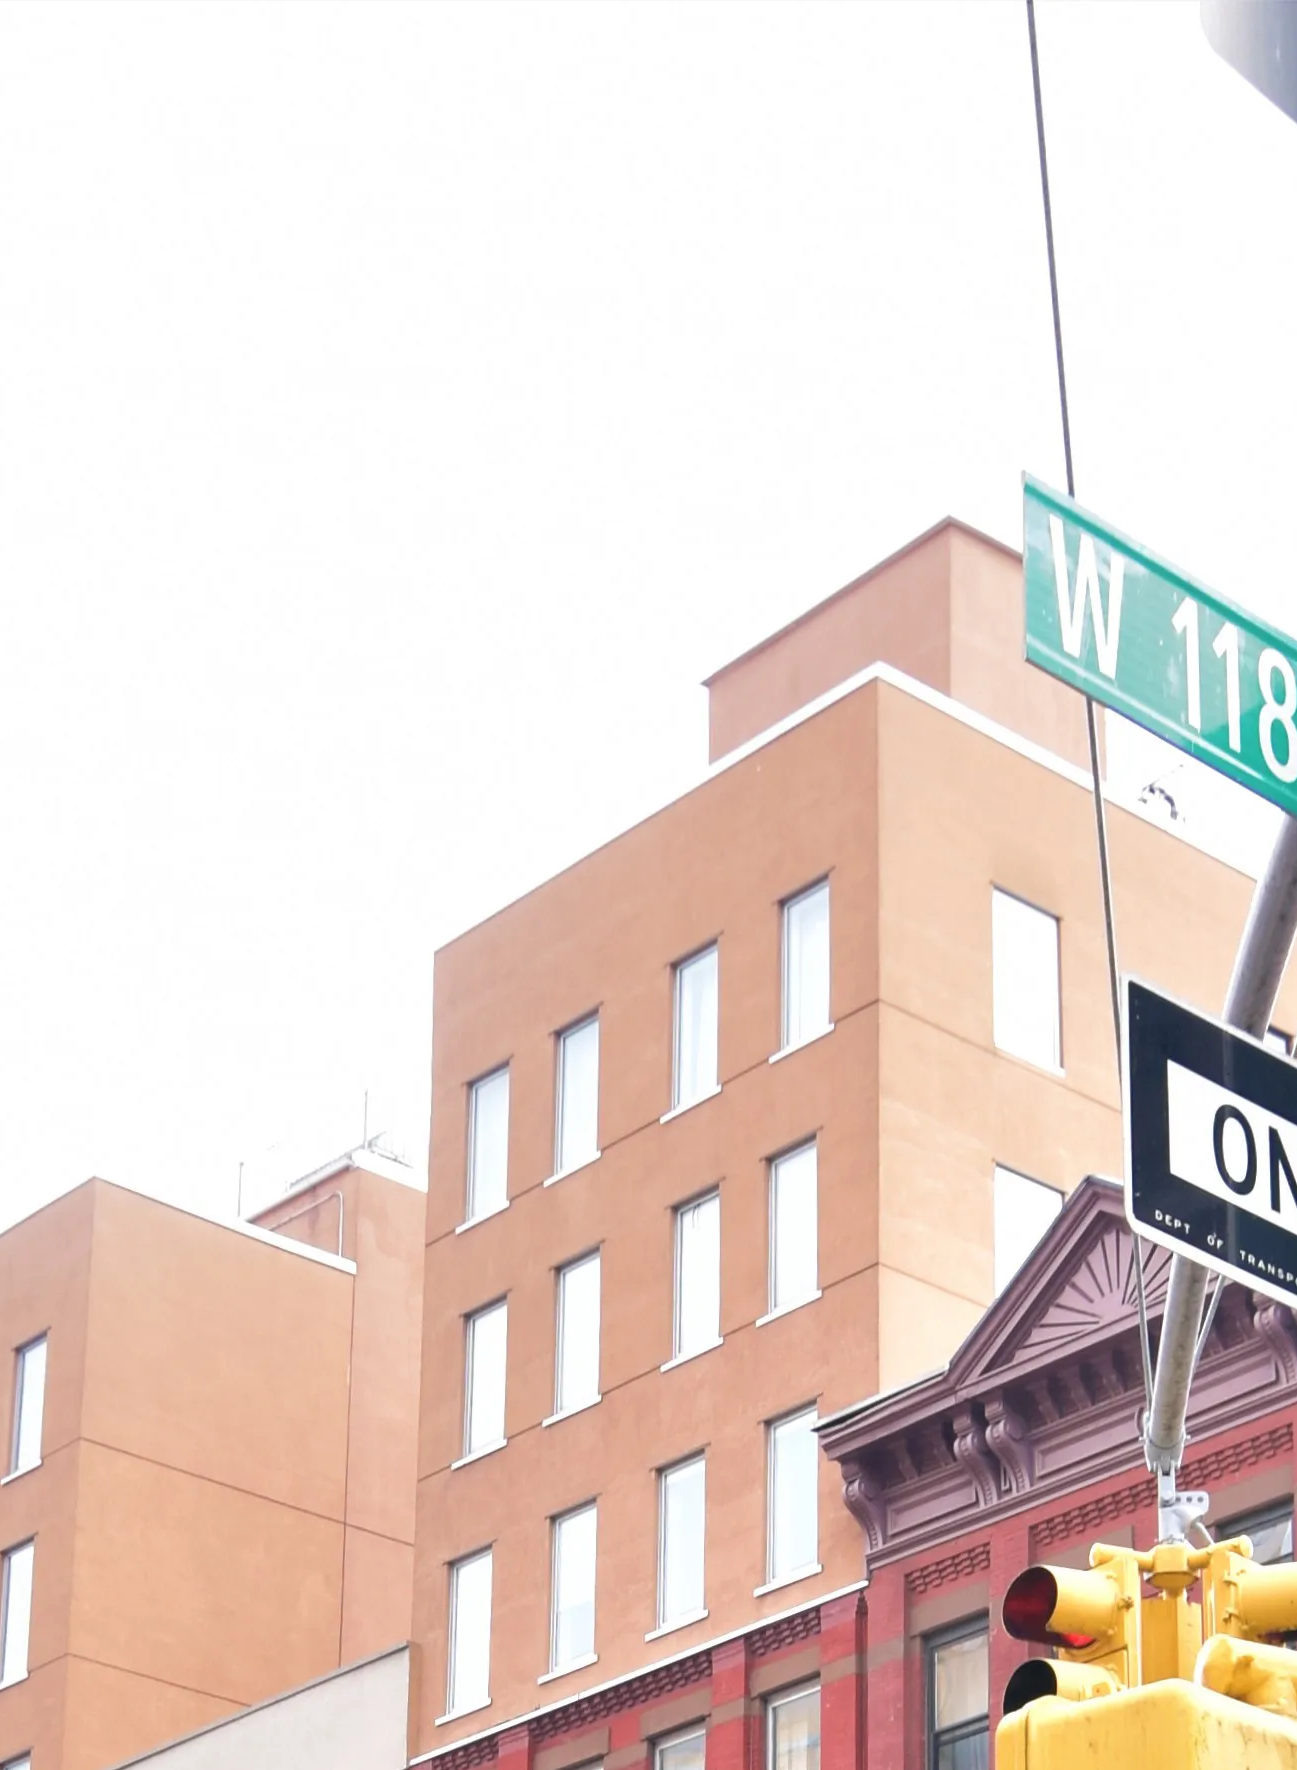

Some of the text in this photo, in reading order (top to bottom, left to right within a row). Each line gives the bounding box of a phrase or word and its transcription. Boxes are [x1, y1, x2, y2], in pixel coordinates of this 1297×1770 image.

[1048, 513, 1125, 681] W
[1154, 1209, 1192, 1235] DEPT
[1206, 1232, 1225, 1250] OF
